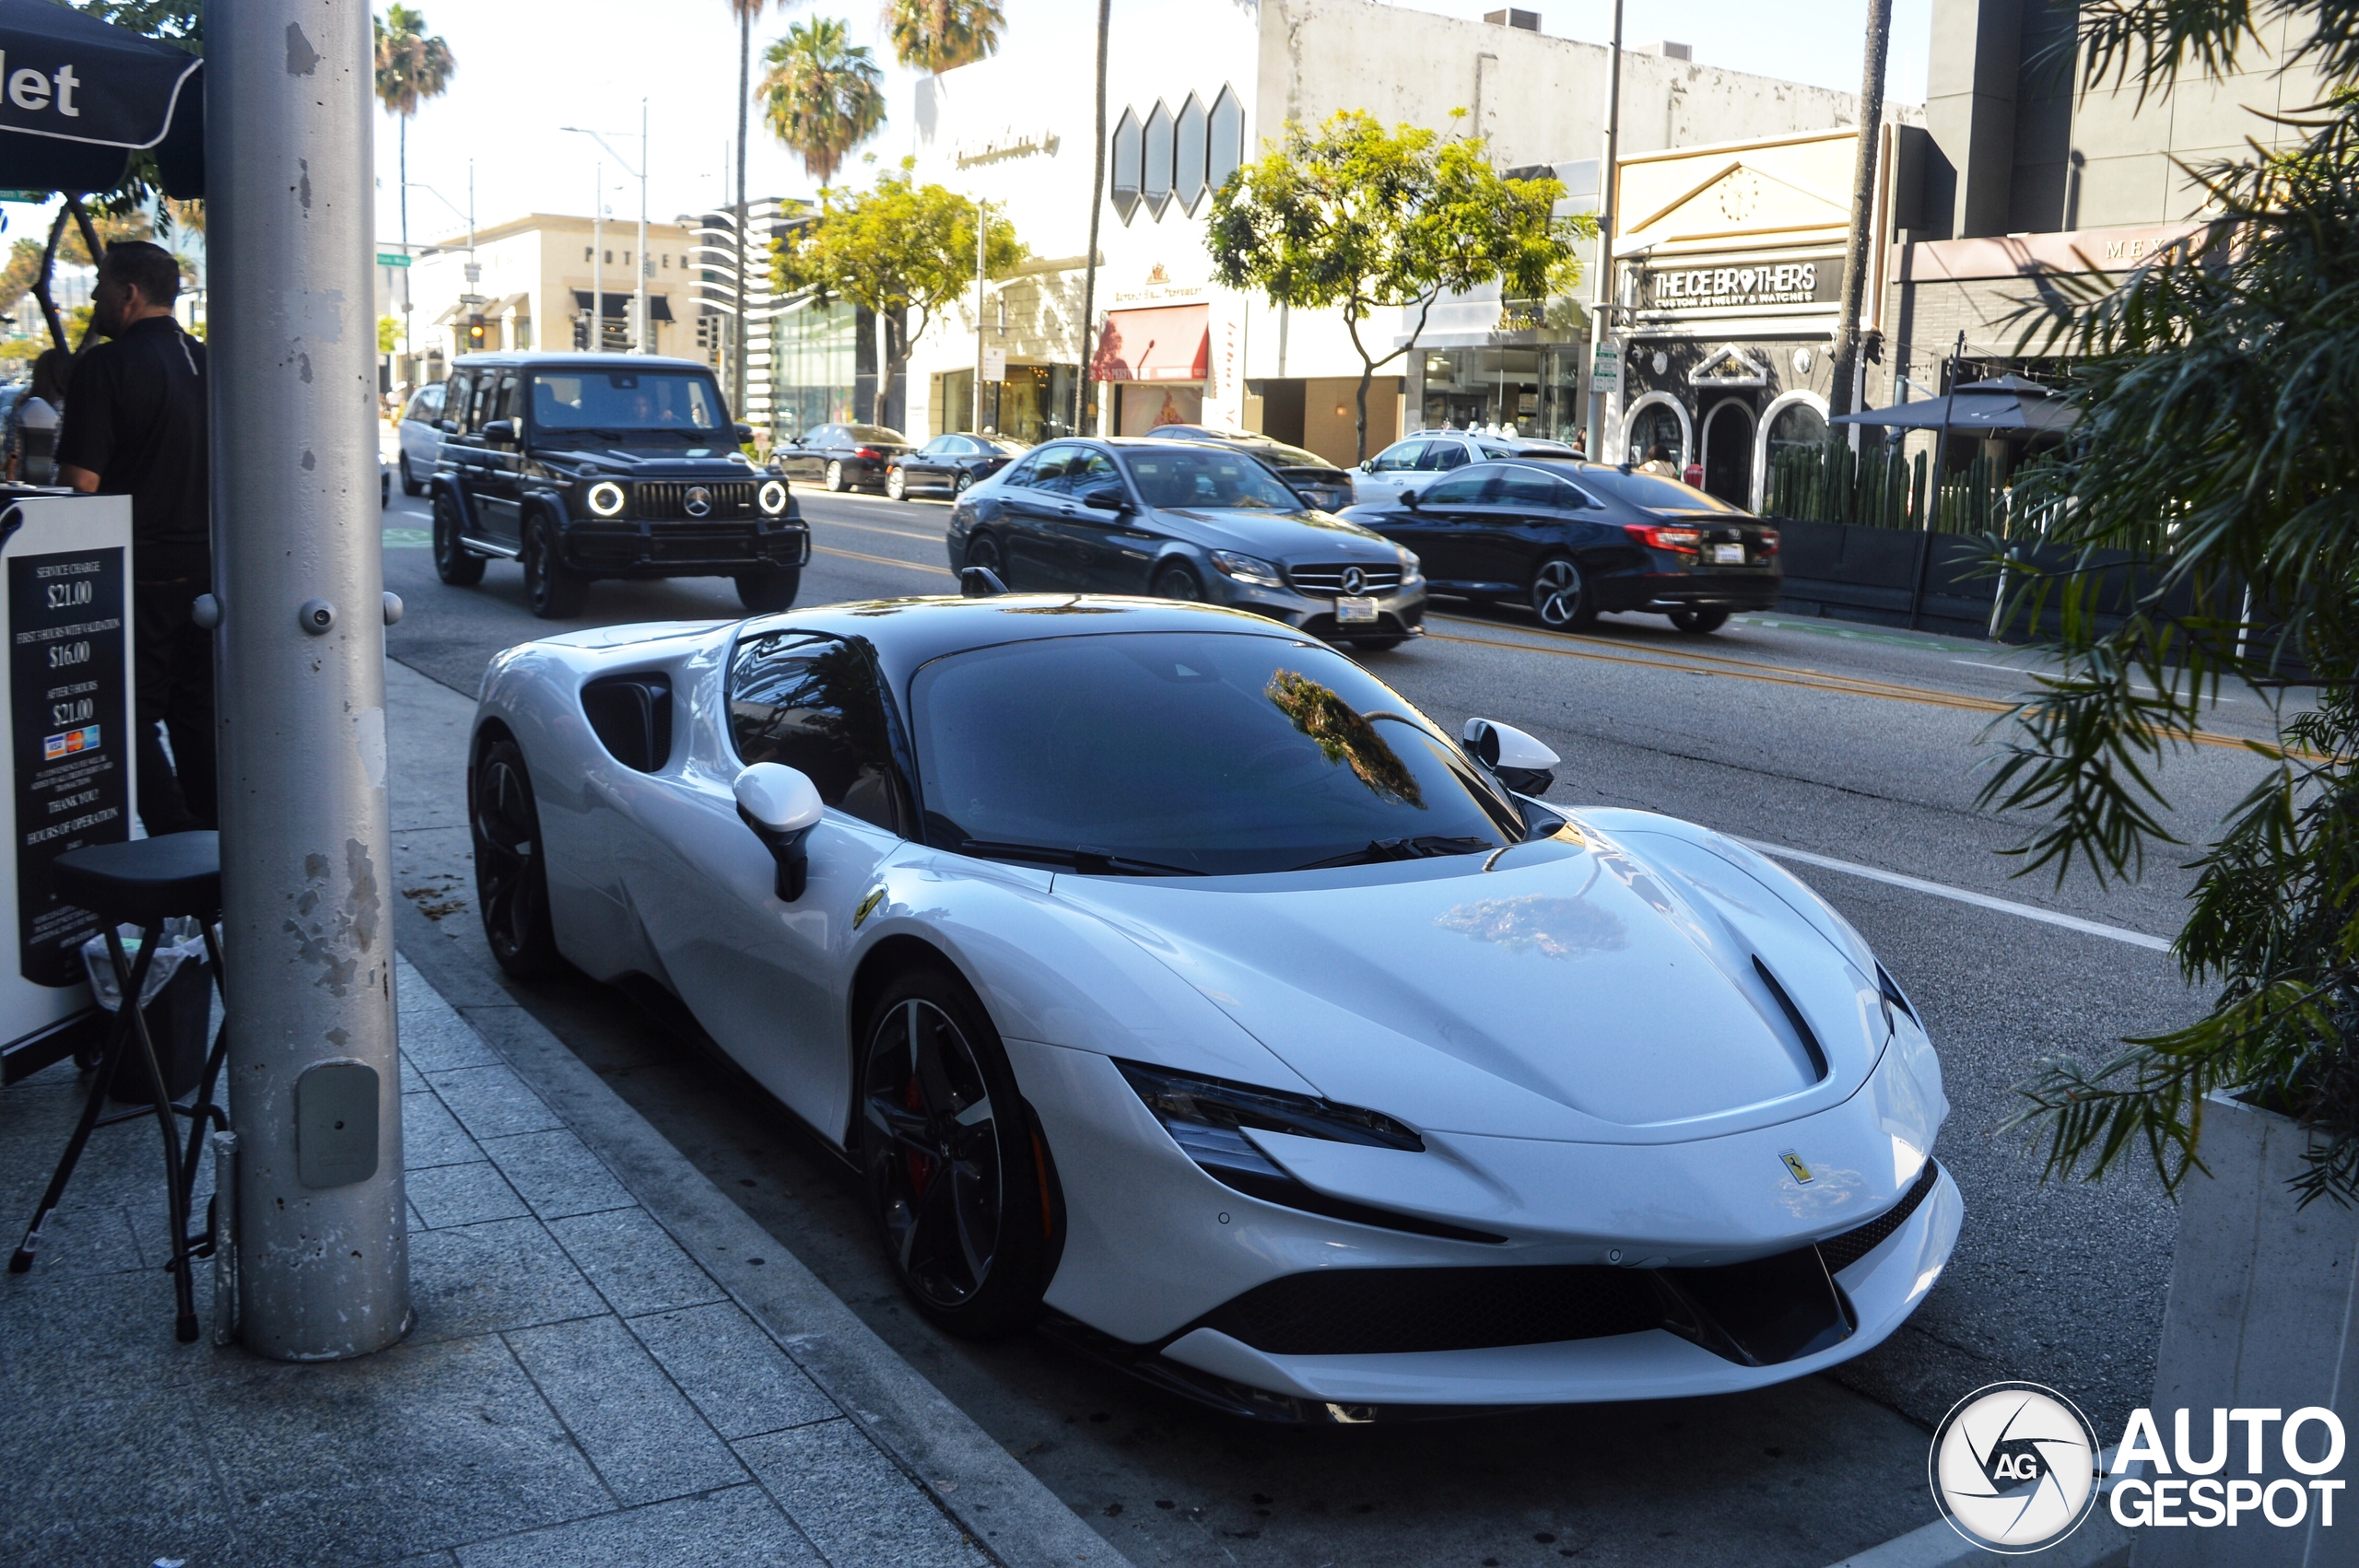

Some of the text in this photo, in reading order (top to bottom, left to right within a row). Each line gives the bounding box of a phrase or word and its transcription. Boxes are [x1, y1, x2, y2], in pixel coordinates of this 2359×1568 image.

[1653, 272, 1684, 298] THE
[1684, 270, 1713, 297] ICE
[1655, 291, 1813, 309] CUSTOM JEWELRY & WATCHES
[37, 561, 100, 578] SERVICE CHARGE
[48, 580, 92, 609] $21.00
[49, 640, 90, 668] $16.00
[53, 698, 93, 726] $21.00
[47, 794, 78, 813] THANK
[26, 825, 58, 845] HOURS
